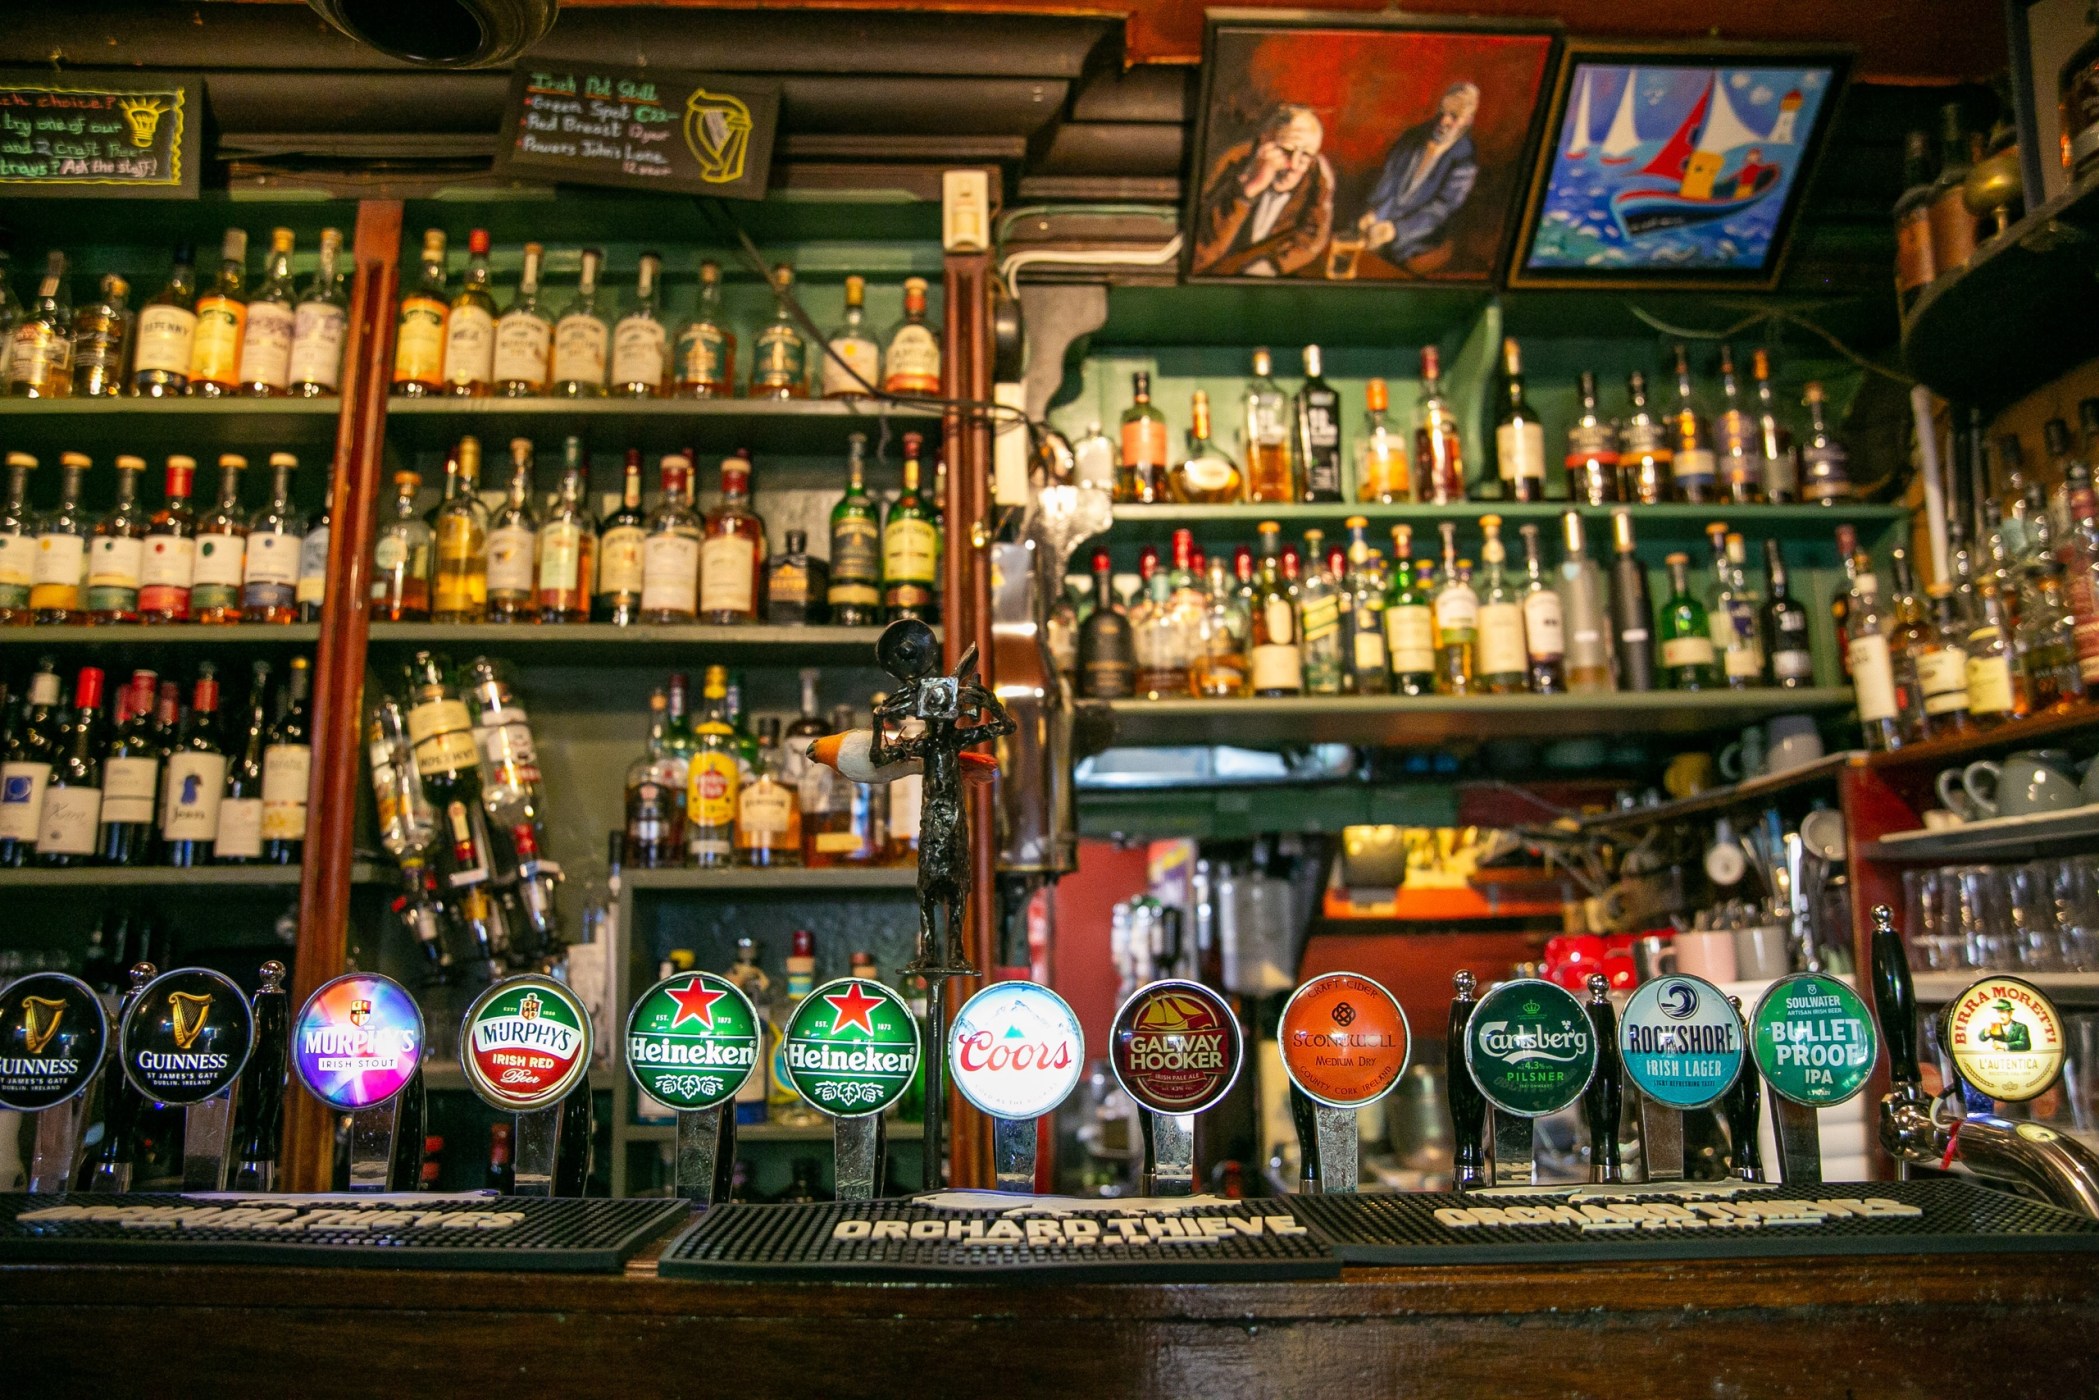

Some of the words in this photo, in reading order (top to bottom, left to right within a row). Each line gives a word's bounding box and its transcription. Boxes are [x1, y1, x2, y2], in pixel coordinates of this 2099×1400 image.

[589, 100, 631, 122] Spot
[1307, 980, 1340, 999] CRAFT
[1346, 980, 1378, 999] CIDER
[1785, 995, 1841, 1009] SOULWATER
[815, 1020, 829, 1028] EST.
[877, 1023, 892, 1031] 1873
[1954, 991, 1990, 1045] BIRRA
[1991, 986, 2057, 1043] MORETTI
[483, 1021, 572, 1051] MURPHY'S
[1478, 1021, 1588, 1057] Carlsberg
[1629, 1023, 1735, 1054] ROCKSHORE
[1770, 1018, 1861, 1043] BULLET
[305, 1028, 415, 1055] MURP'S
[631, 1037, 755, 1066] Heineken
[958, 1030, 1072, 1072] Coors
[1129, 1035, 1223, 1054] GALWAY
[138, 1050, 228, 1070] GUINNESS
[322, 1060, 352, 1068] IRISH
[358, 1059, 395, 1067] STOUT
[492, 1053, 527, 1068] IRISH
[529, 1056, 555, 1070] RED
[788, 1043, 915, 1073] Heineken
[1130, 1052, 1225, 1071] HOOKER
[1776, 1043, 1860, 1067] PROOF
[1979, 1058, 2039, 1070] L'AUTENTICA
[0, 1056, 79, 1075] UINNESS
[1646, 1059, 1680, 1076] IRISH
[1685, 1060, 1722, 1077] LAGER
[159, 1072, 195, 1080] JAMES'S
[500, 1068, 541, 1084] Beer
[1300, 1065, 1331, 1091] COUNTY
[1334, 1086, 1358, 1095] CORK
[1362, 1066, 1393, 1092] IRELAND
[1506, 1072, 1565, 1081] PILSNER
[1804, 1069, 1834, 1084] IPA
[292, 1208, 527, 1229] THIEVES
[833, 1219, 1100, 1241] ORCHARD
[1106, 1215, 1307, 1238] THIEVE
